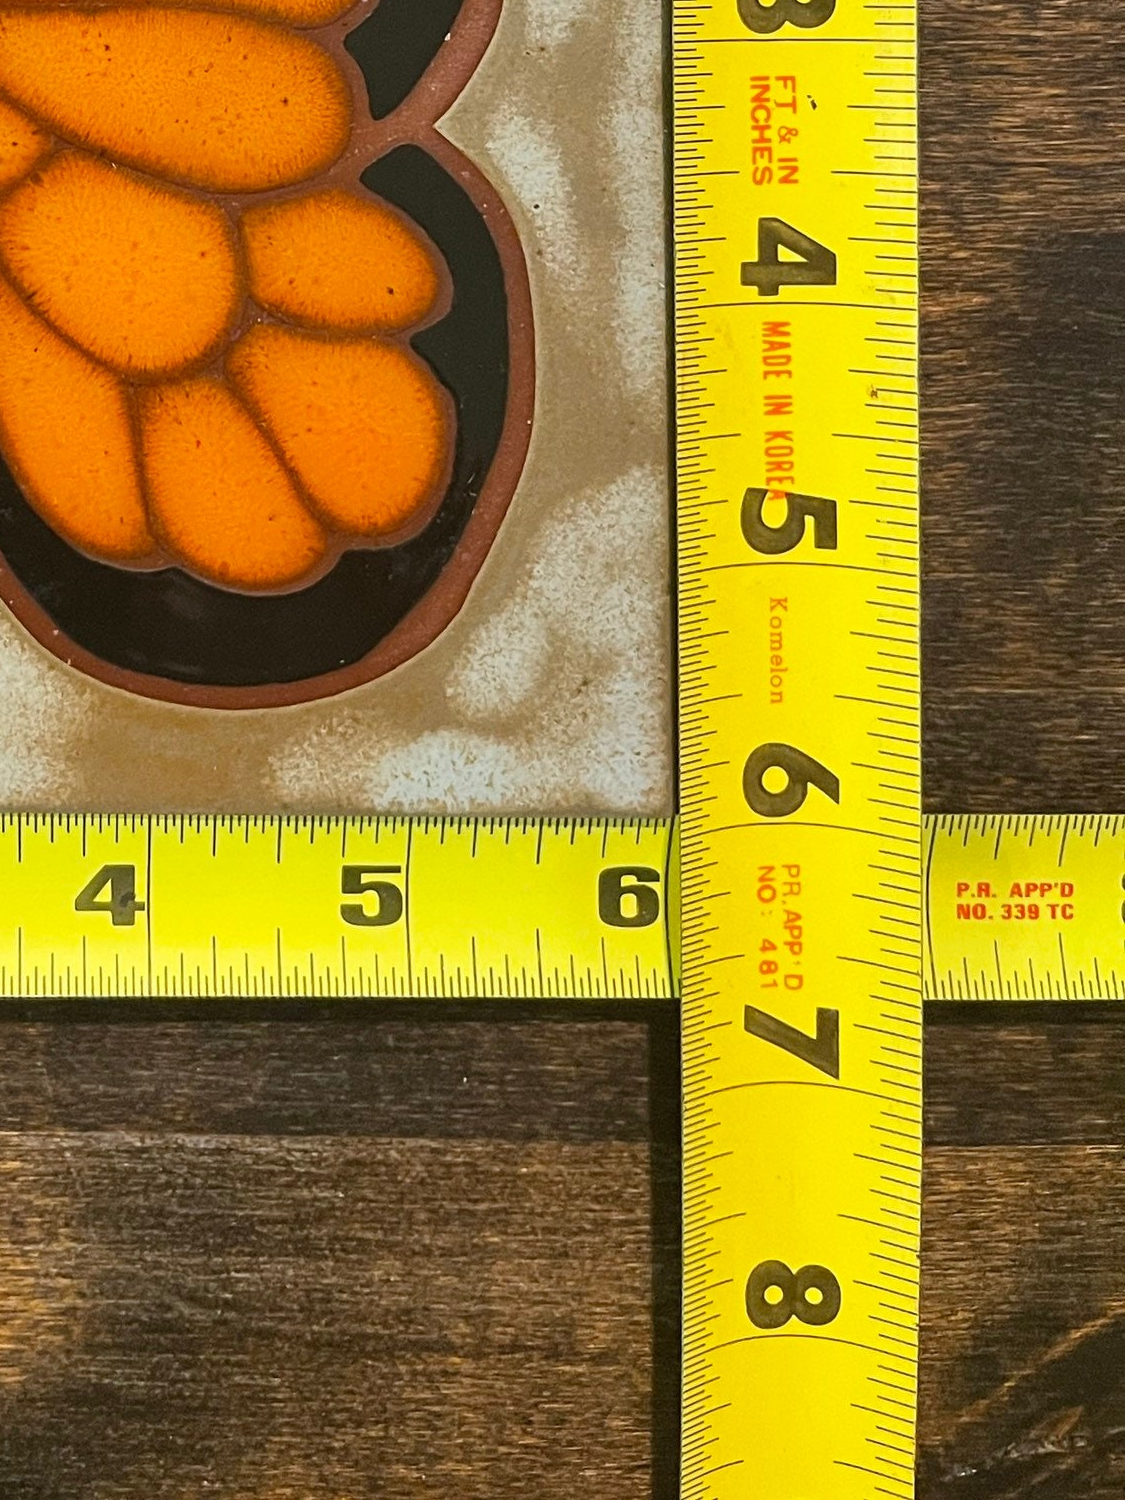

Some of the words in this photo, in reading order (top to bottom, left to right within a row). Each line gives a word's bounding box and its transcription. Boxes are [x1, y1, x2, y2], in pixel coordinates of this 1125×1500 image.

[775, 75, 798, 114] FT
[750, 75, 774, 186] INCHES
[777, 157, 799, 184] IN
[740, 217, 837, 296] 4
[761, 321, 792, 380] MADE
[763, 394, 793, 416] IN
[740, 487, 837, 554] 5
[768, 596, 789, 704] Komelon
[742, 742, 840, 818] 6
[74, 864, 146, 926] 4
[340, 865, 403, 927] 5
[598, 866, 661, 928] 6
[956, 881, 997, 898] P.R.
[1009, 881, 1074, 898] APP'D
[956, 903, 994, 920] NO.
[1001, 903, 1040, 920] 339
[1046, 903, 1074, 920] TC
[758, 938, 779, 989] 481
[743, 1004, 840, 1081] 7
[745, 1259, 842, 1329] 8
